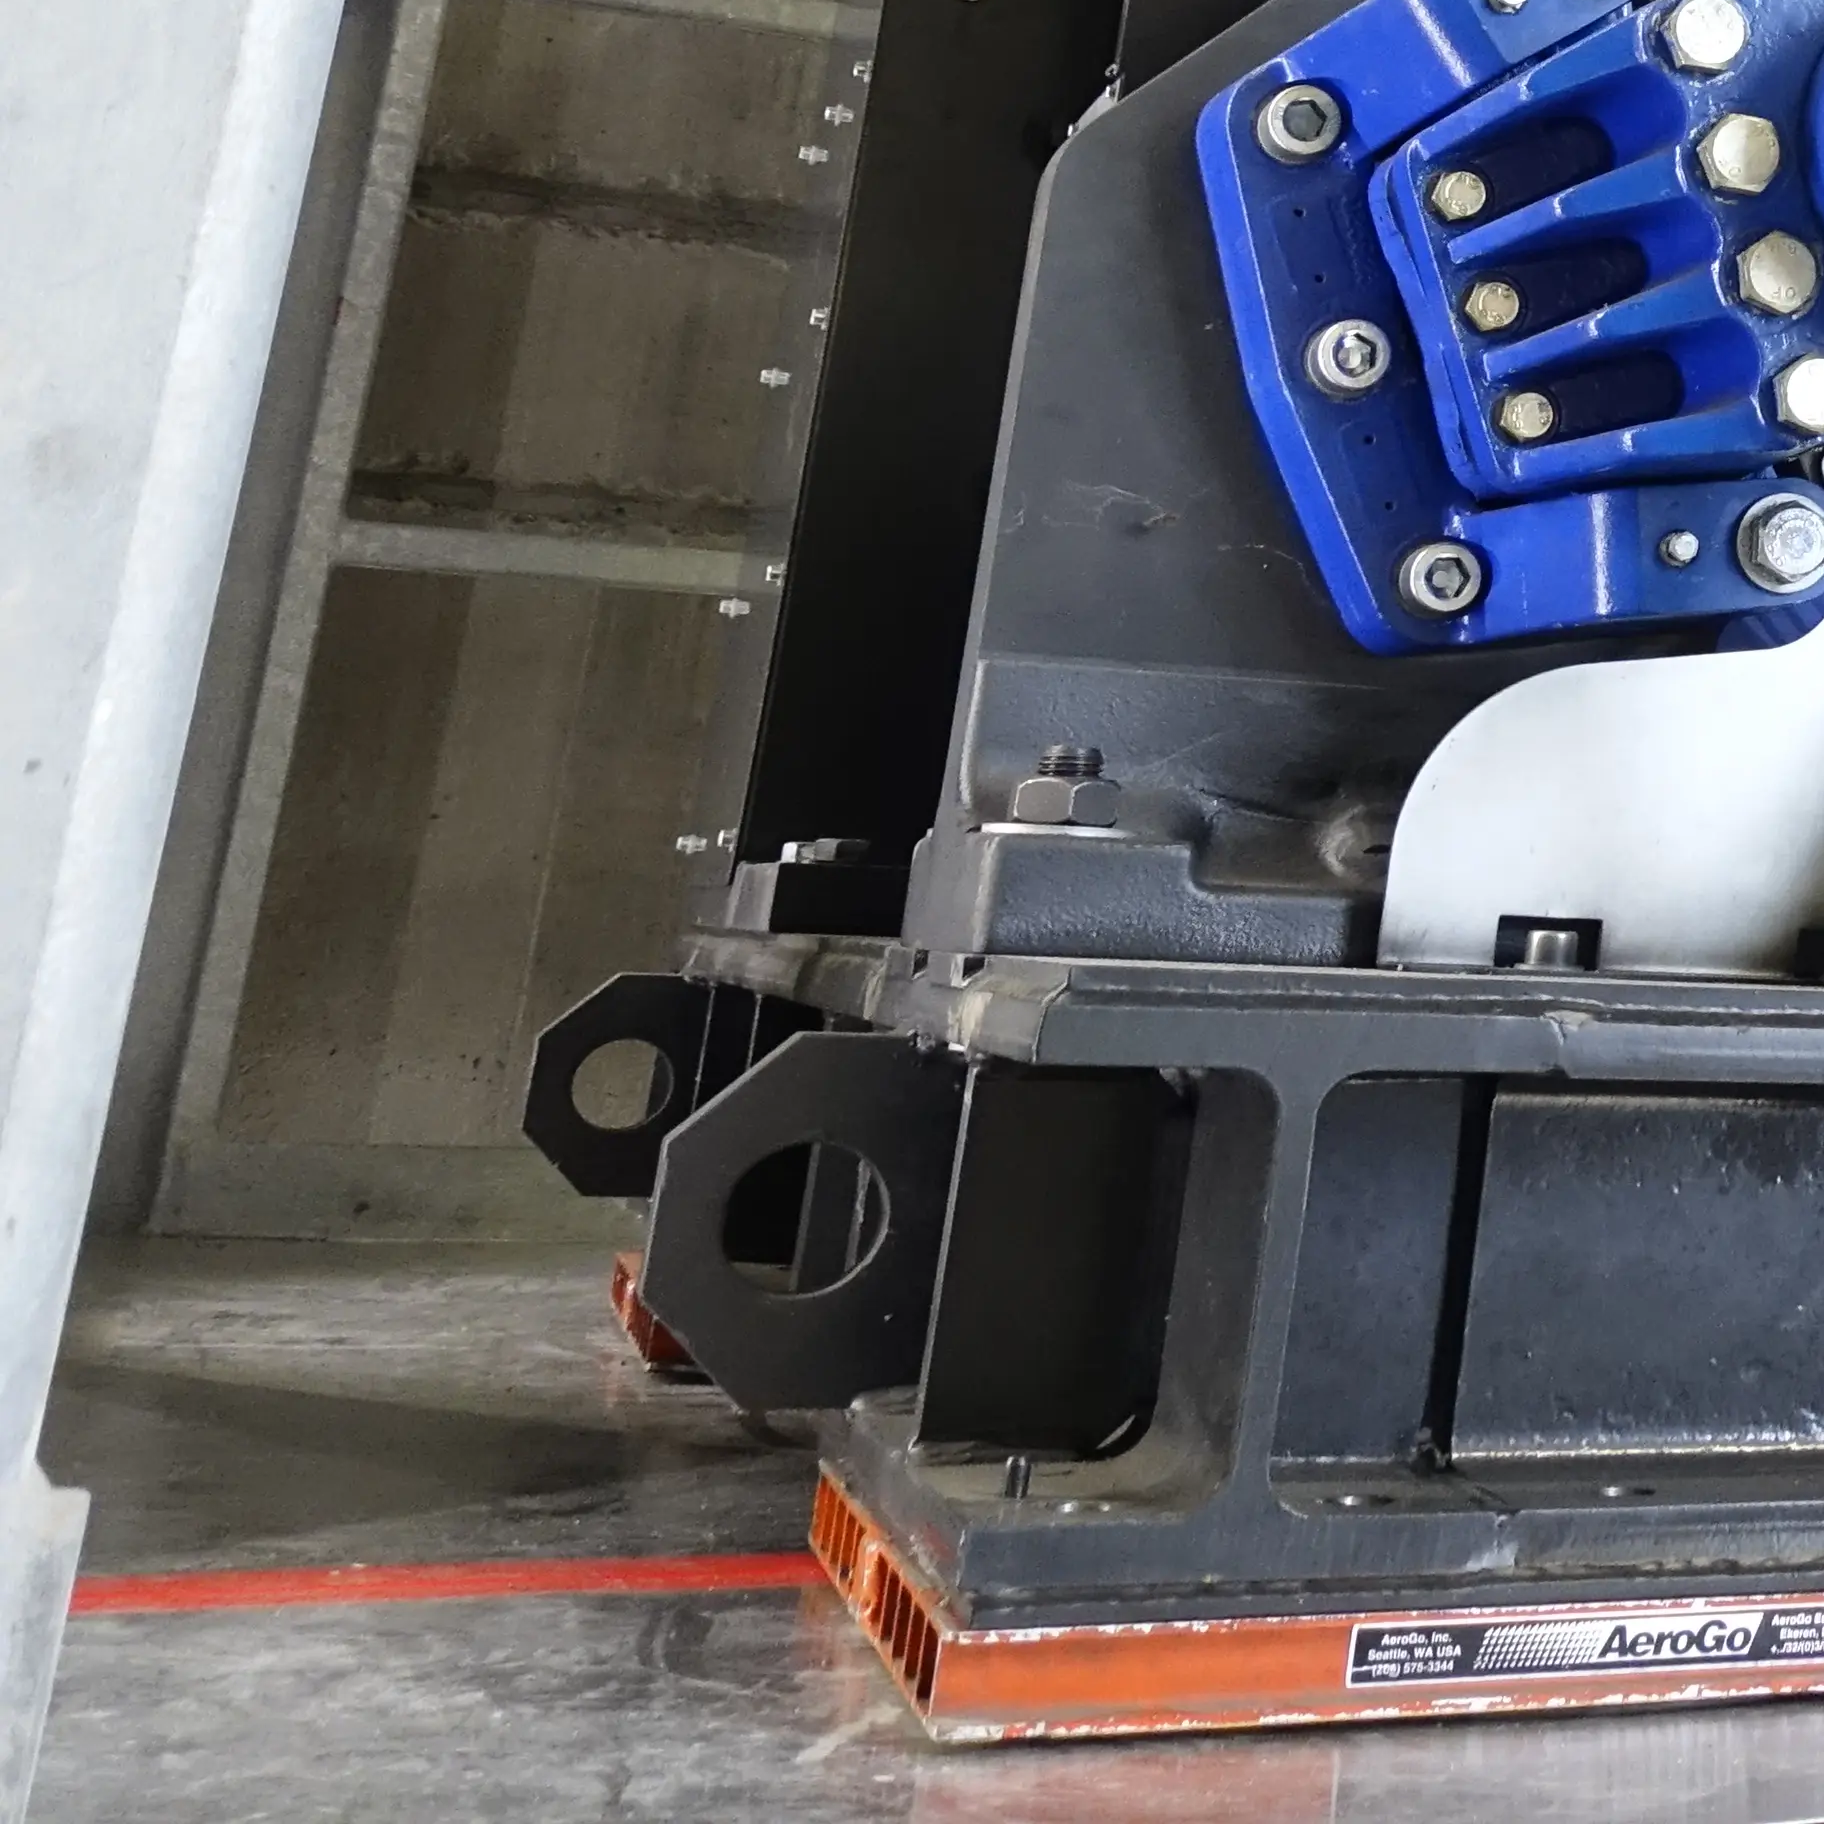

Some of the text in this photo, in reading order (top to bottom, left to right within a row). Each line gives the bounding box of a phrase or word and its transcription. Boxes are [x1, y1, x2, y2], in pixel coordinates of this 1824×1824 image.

[1431, 1631, 1452, 1644] Inc.
[1597, 1619, 1752, 1658] AeroGo
[1779, 1627, 1820, 1640] Ekeren,
[1367, 1644, 1462, 1661] Seattle, WA USA
